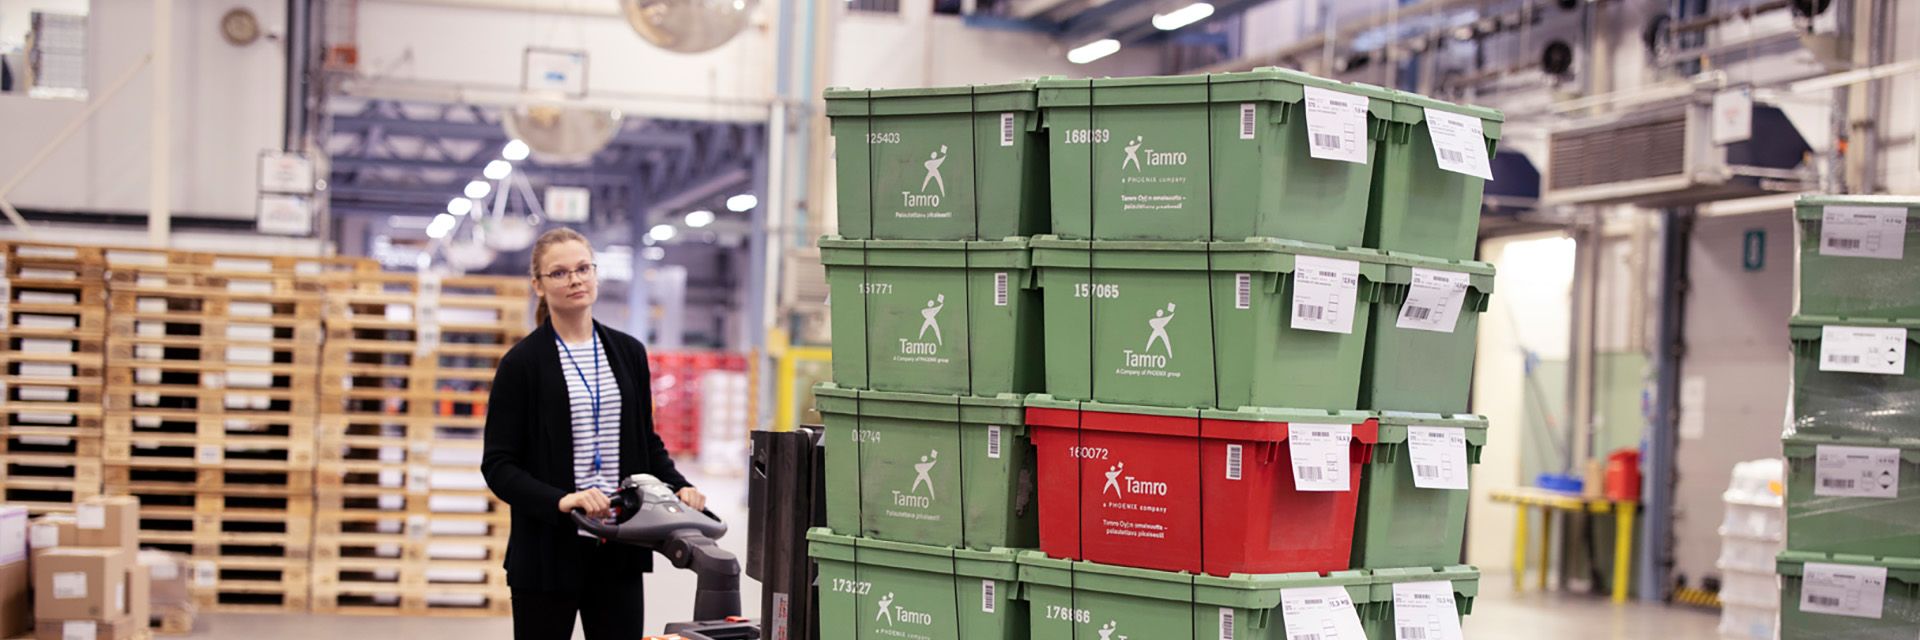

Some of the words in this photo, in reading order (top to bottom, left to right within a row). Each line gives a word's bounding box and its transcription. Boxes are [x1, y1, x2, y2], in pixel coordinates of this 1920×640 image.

[1144, 149, 1187, 165] Tamro
[902, 191, 940, 208] Tamro
[1074, 283, 1120, 298] 157065
[899, 338, 937, 355] Tamro
[1123, 349, 1166, 368] Tamro
[1069, 446, 1109, 460] 160072
[1124, 476, 1167, 496] Tamro
[891, 490, 929, 508] Tamro
[895, 605, 932, 626] Tamro
